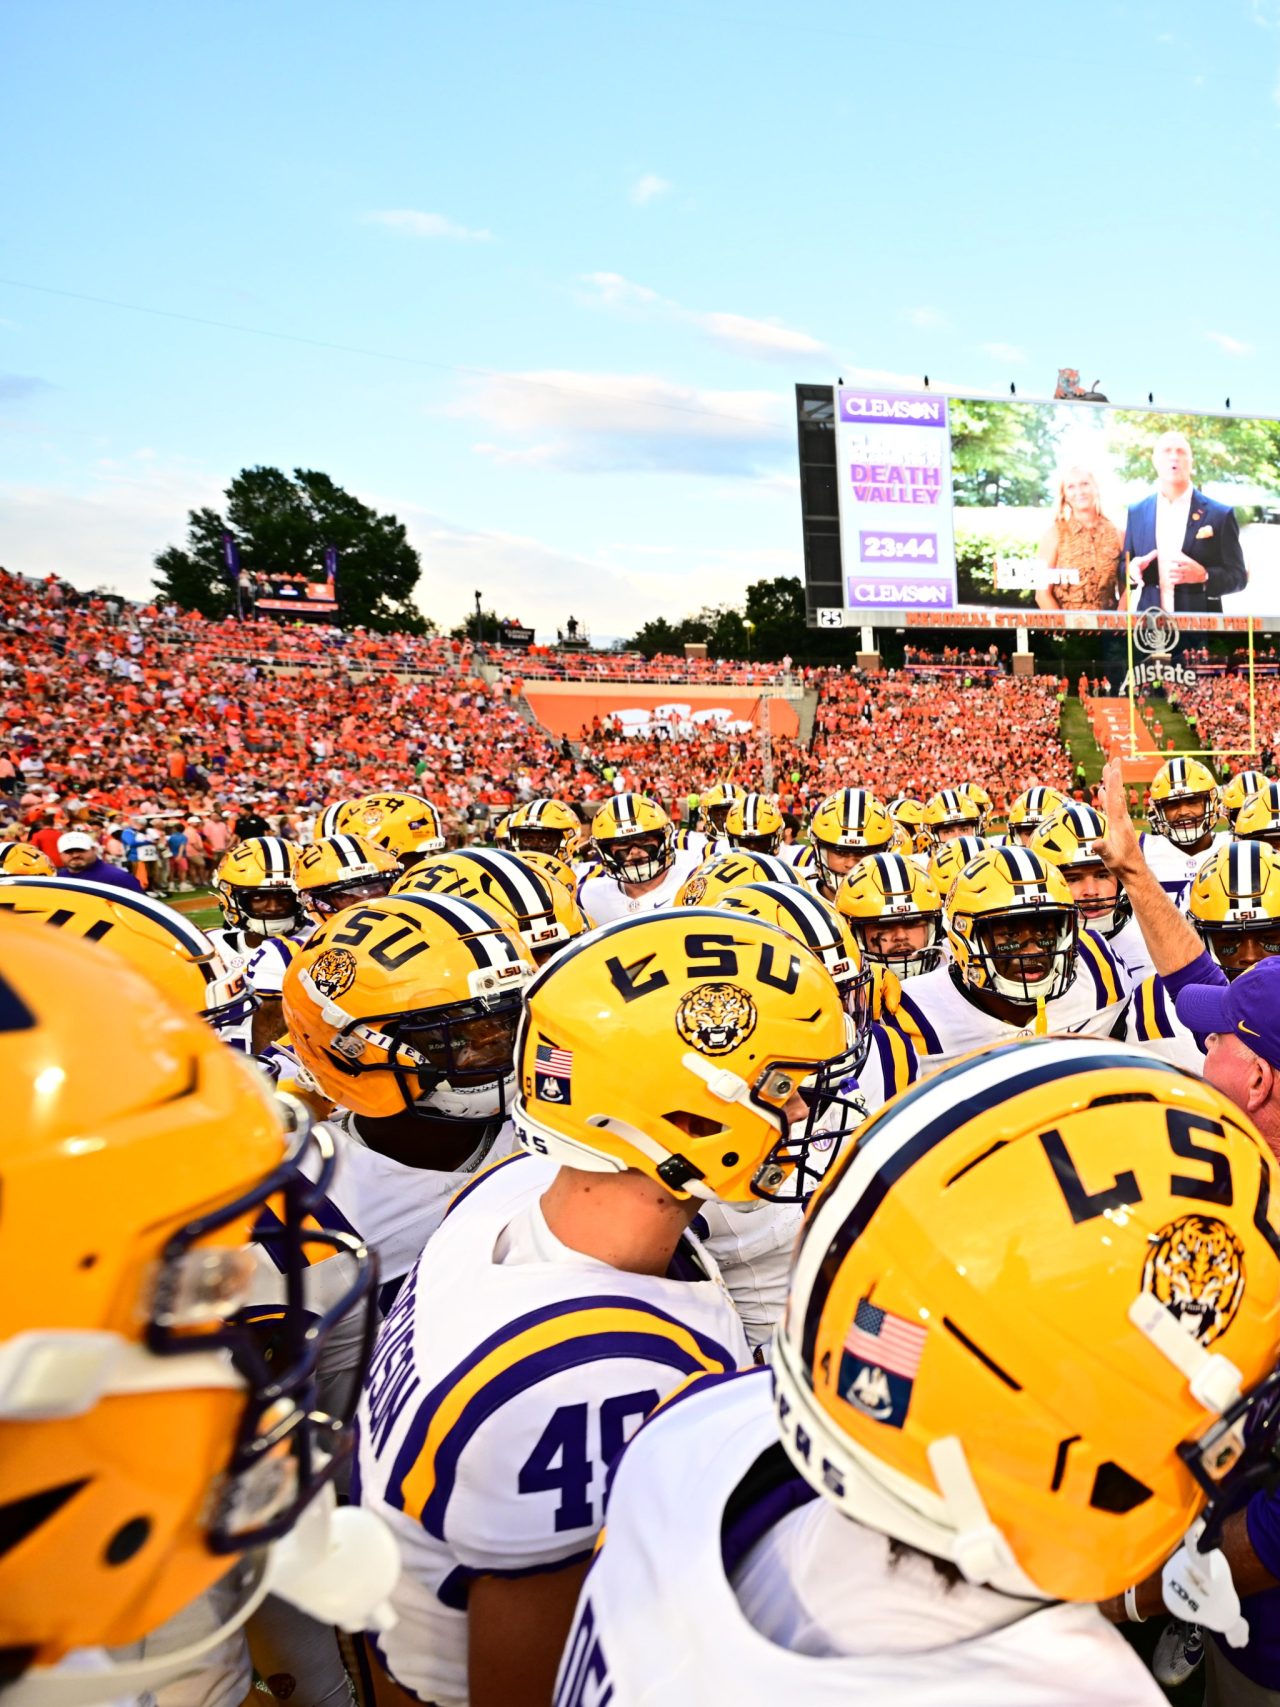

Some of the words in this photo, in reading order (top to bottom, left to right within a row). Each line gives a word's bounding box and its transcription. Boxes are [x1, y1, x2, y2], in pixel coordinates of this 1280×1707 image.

[845, 397, 940, 420] CLEMSON
[850, 464, 940, 486] DEATH
[852, 485, 939, 505] VALLEY
[864, 537, 935, 558] 23:44
[854, 584, 947, 603] CLEMSON
[905, 612, 991, 626] MEMORIAL
[994, 614, 1066, 628] STADIUM
[1119, 660, 1198, 696] Allstate
[621, 826, 637, 835] LSU
[1085, 849, 1099, 857] LS
[1022, 895, 1047, 904] LSU
[890, 904, 912, 914] LSU
[1233, 910, 1257, 921] LSU
[530, 928, 559, 943] LSU
[496, 965, 522, 980] LSU
[605, 933, 801, 1003] LSU
[830, 961, 850, 977] SU
[363, 1028, 429, 1065] TIER
